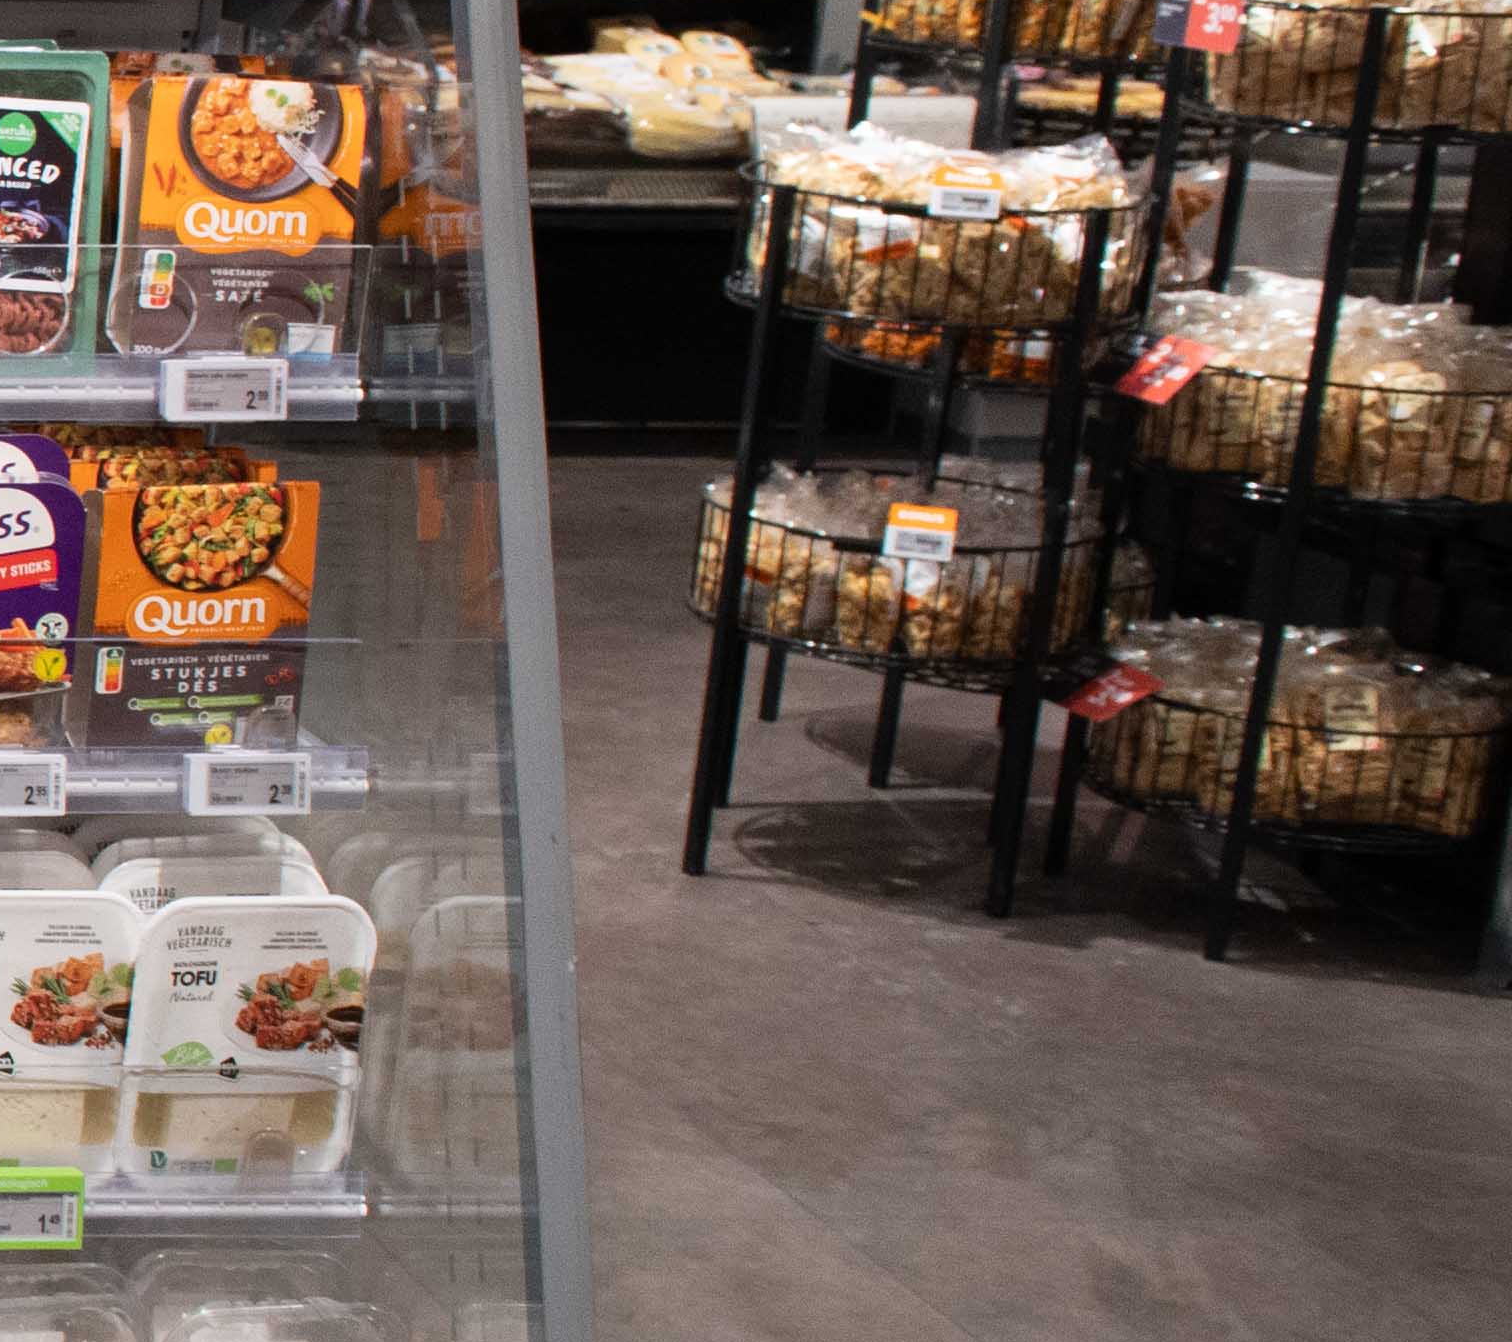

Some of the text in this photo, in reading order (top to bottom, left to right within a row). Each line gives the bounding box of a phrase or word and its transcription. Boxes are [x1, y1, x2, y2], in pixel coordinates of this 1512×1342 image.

[184, 201, 307, 243] Quorn
[10, 560, 51, 580] STICKS
[134, 595, 266, 635] Quorn
[151, 664, 247, 681] STUKJES
